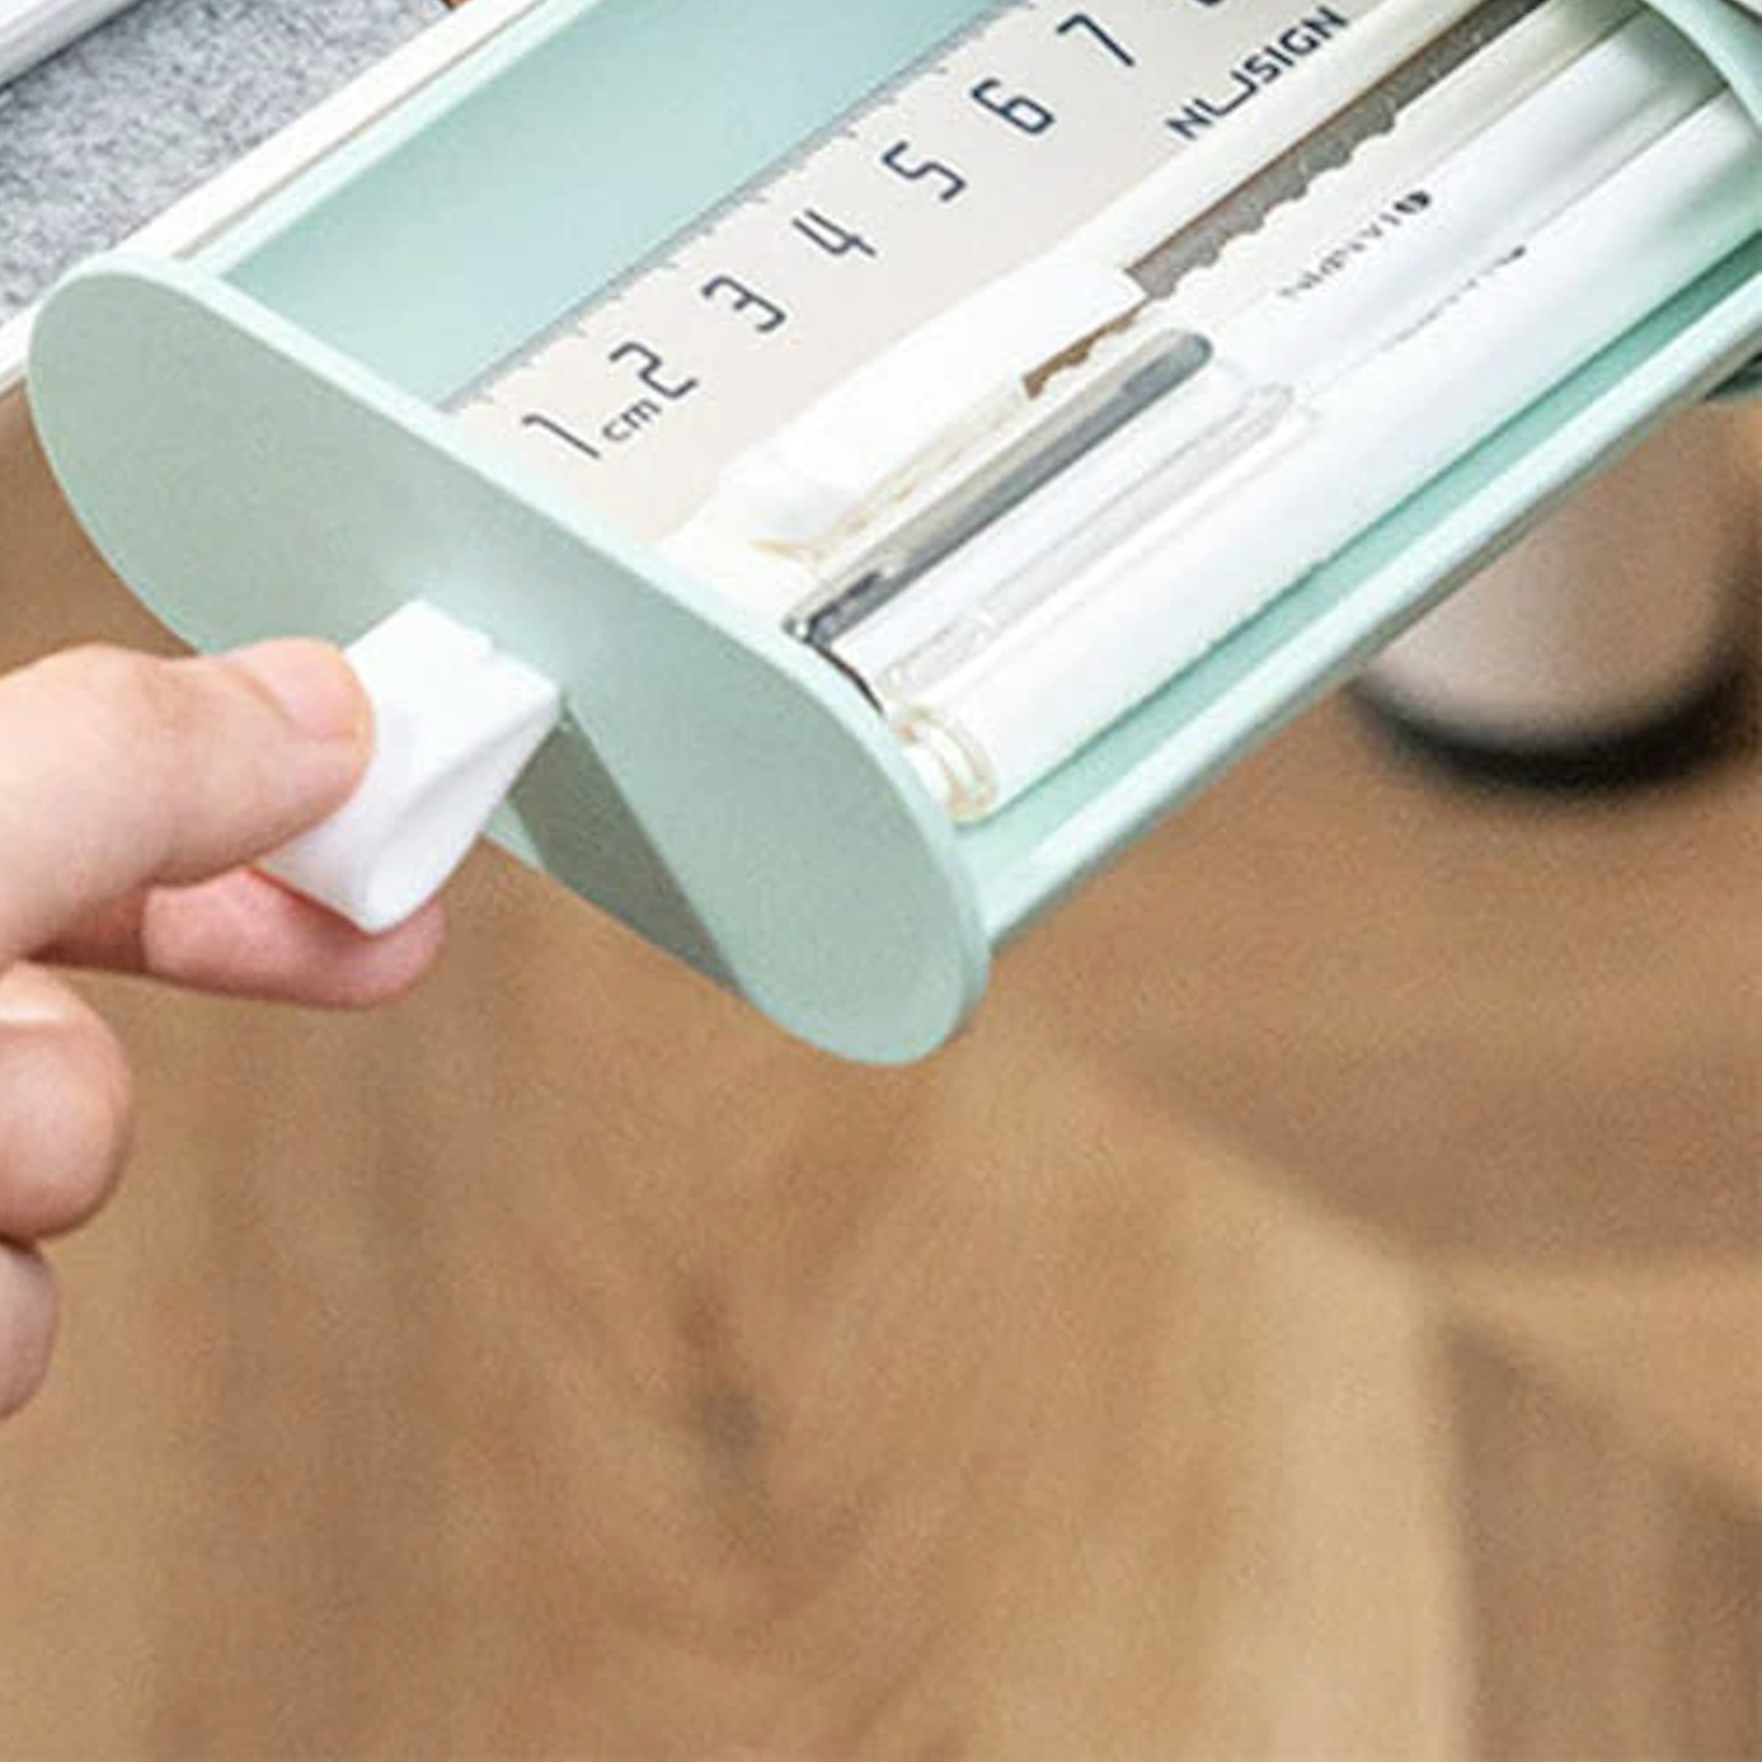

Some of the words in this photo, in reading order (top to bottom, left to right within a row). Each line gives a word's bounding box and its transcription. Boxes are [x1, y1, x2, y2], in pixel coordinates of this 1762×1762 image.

[520, 412, 602, 460] 1
[608, 340, 699, 400] 2
[700, 275, 787, 333] 3
[790, 208, 878, 258] 4
[880, 140, 967, 202] 5
[969, 77, 1056, 136] 6
[1055, 12, 1136, 68] 7
[601, 399, 663, 443] cm
